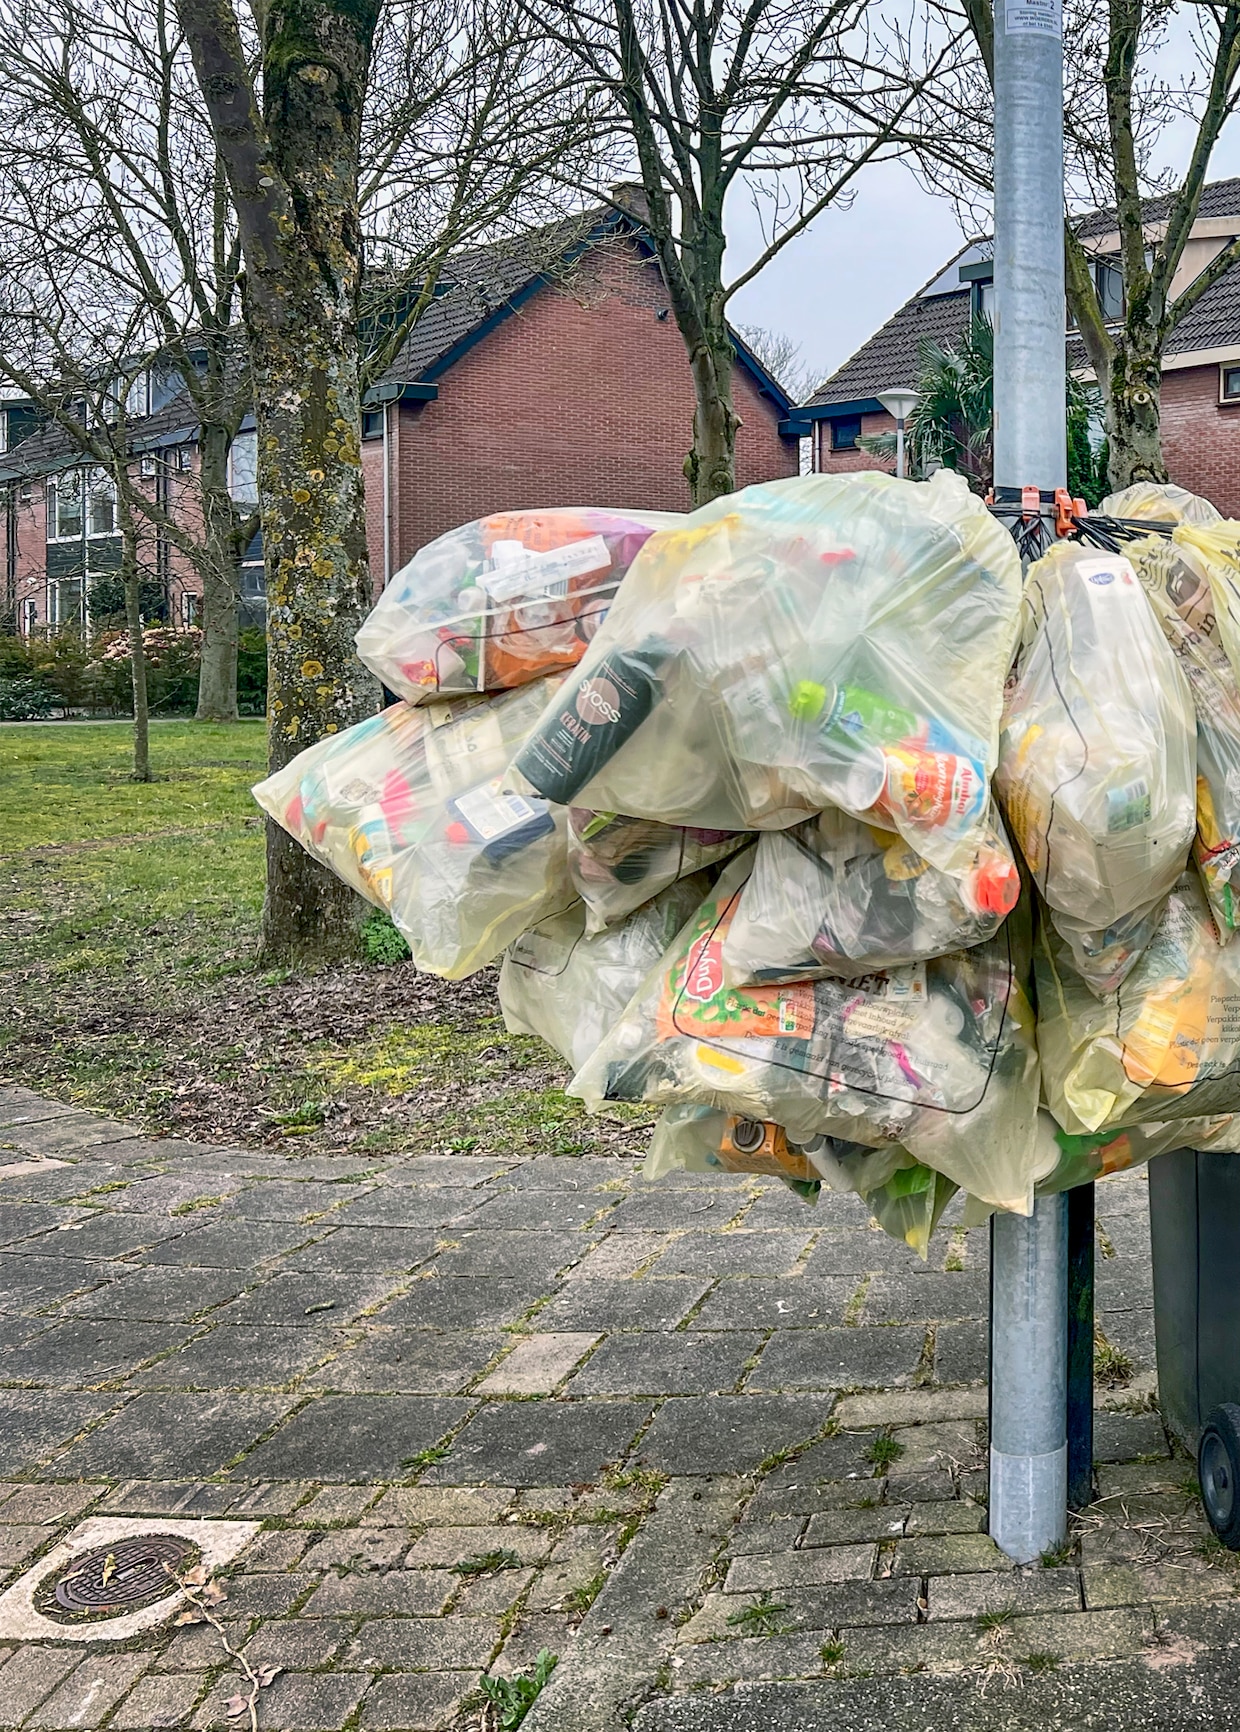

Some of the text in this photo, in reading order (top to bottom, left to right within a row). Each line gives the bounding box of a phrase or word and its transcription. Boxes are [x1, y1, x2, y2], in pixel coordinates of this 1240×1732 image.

[579, 678, 622, 724] syoss
[558, 710, 592, 745] KERATIN
[868, 1011, 897, 1027] inhoud
